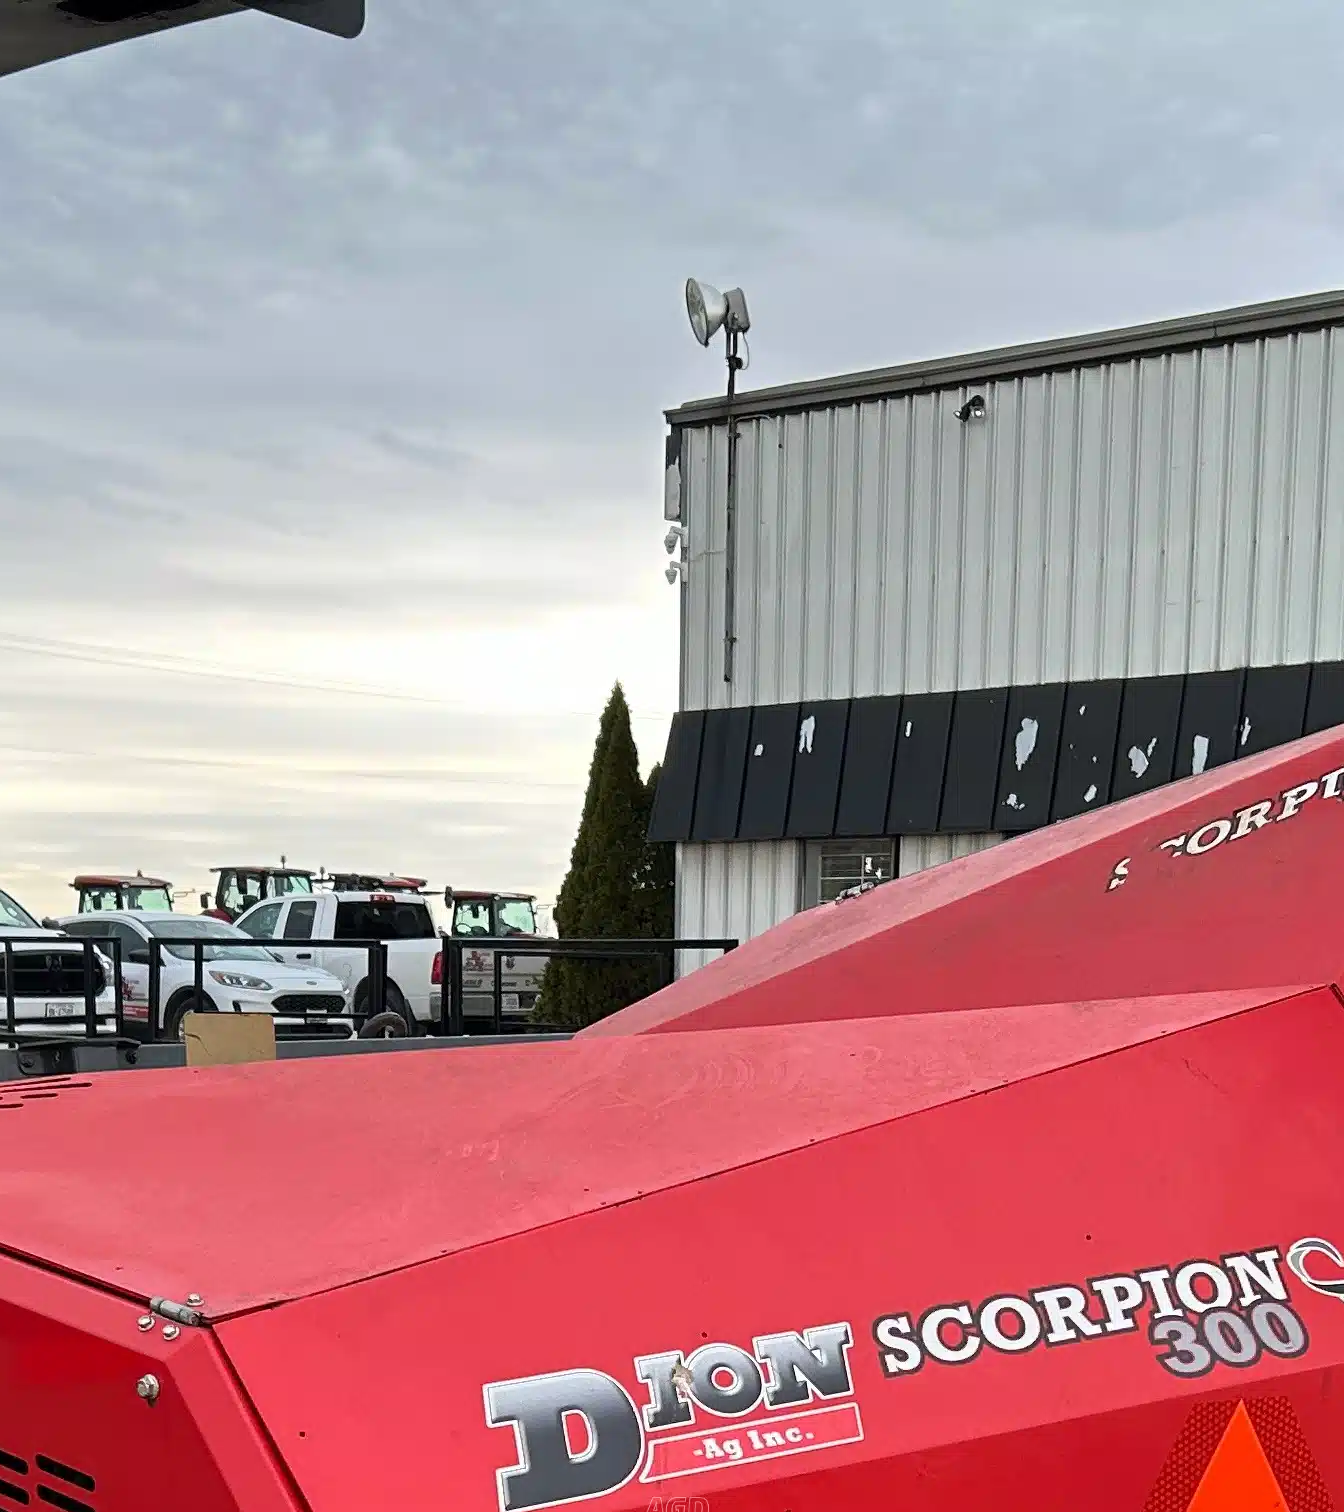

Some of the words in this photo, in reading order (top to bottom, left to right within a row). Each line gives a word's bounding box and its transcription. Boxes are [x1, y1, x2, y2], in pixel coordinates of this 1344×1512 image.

[873, 1246, 1291, 1376] SCORPION
[1151, 1301, 1309, 1377] 300
[747, 1427, 814, 1451] Inc.
